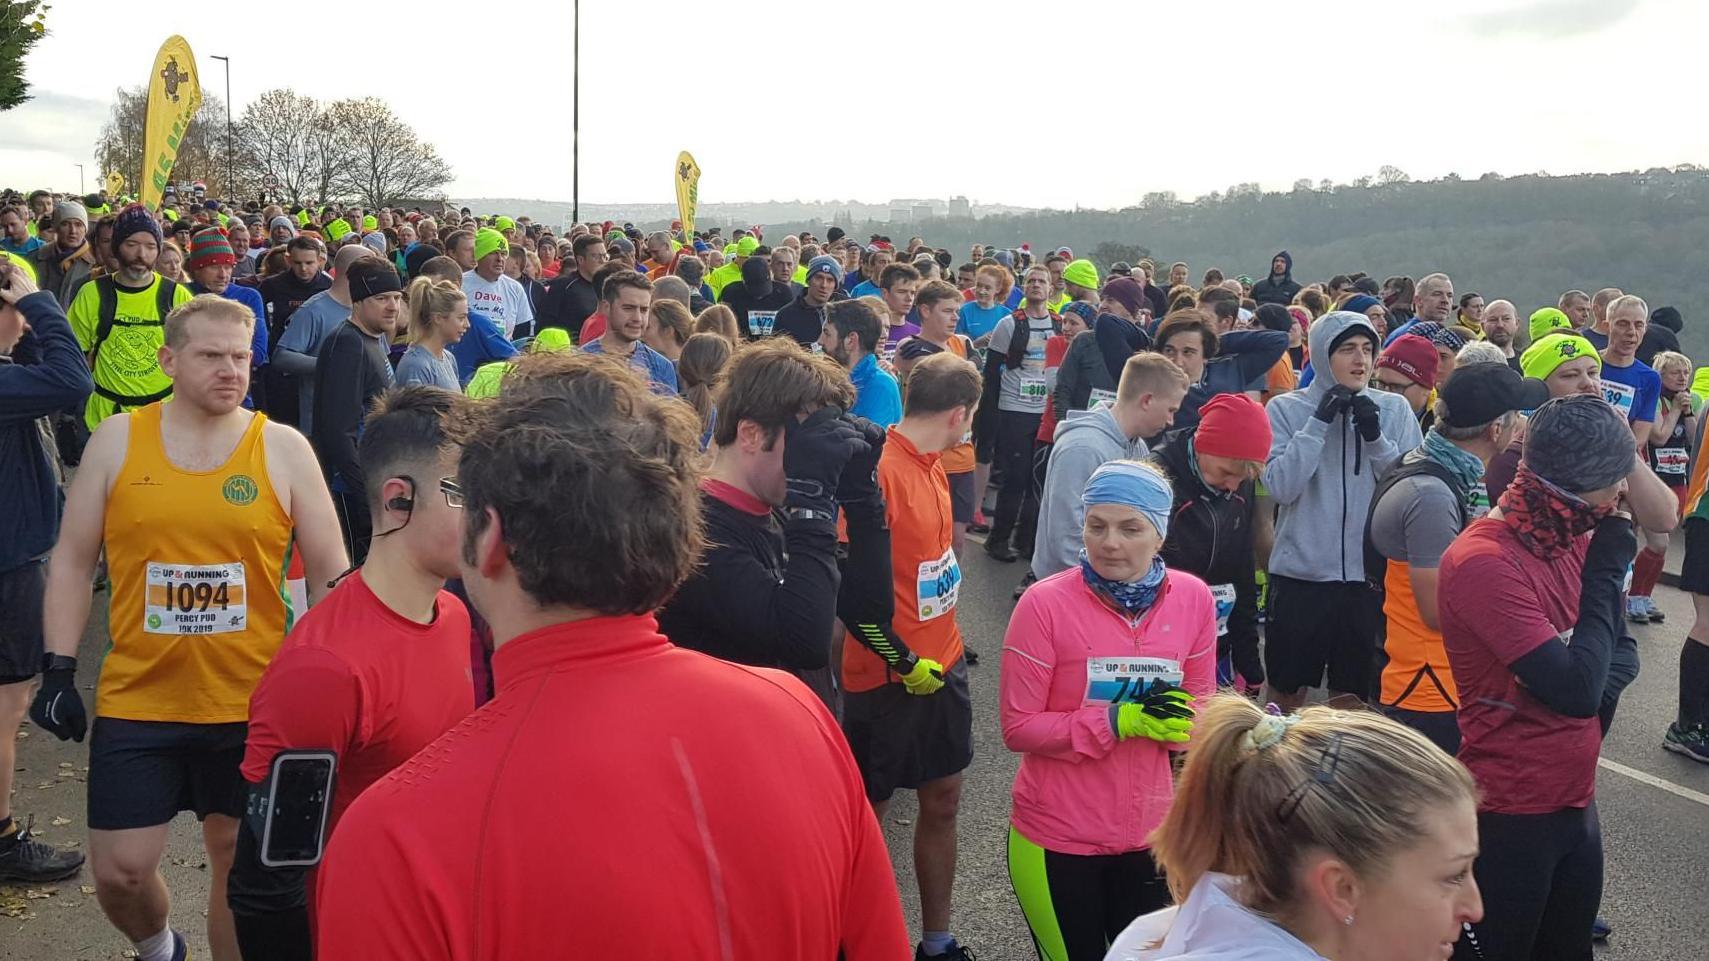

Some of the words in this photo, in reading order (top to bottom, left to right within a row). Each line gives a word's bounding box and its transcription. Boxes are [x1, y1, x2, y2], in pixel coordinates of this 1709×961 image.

[474, 291, 502, 303] Dave
[163, 569, 174, 577] UP
[175, 570, 182, 578] &
[184, 570, 229, 579] RUNNING
[936, 565, 954, 598] 639
[166, 582, 229, 612] 1094
[200, 614, 216, 622] PUD
[193, 625, 213, 633] 2019
[1106, 664, 1118, 672] UP
